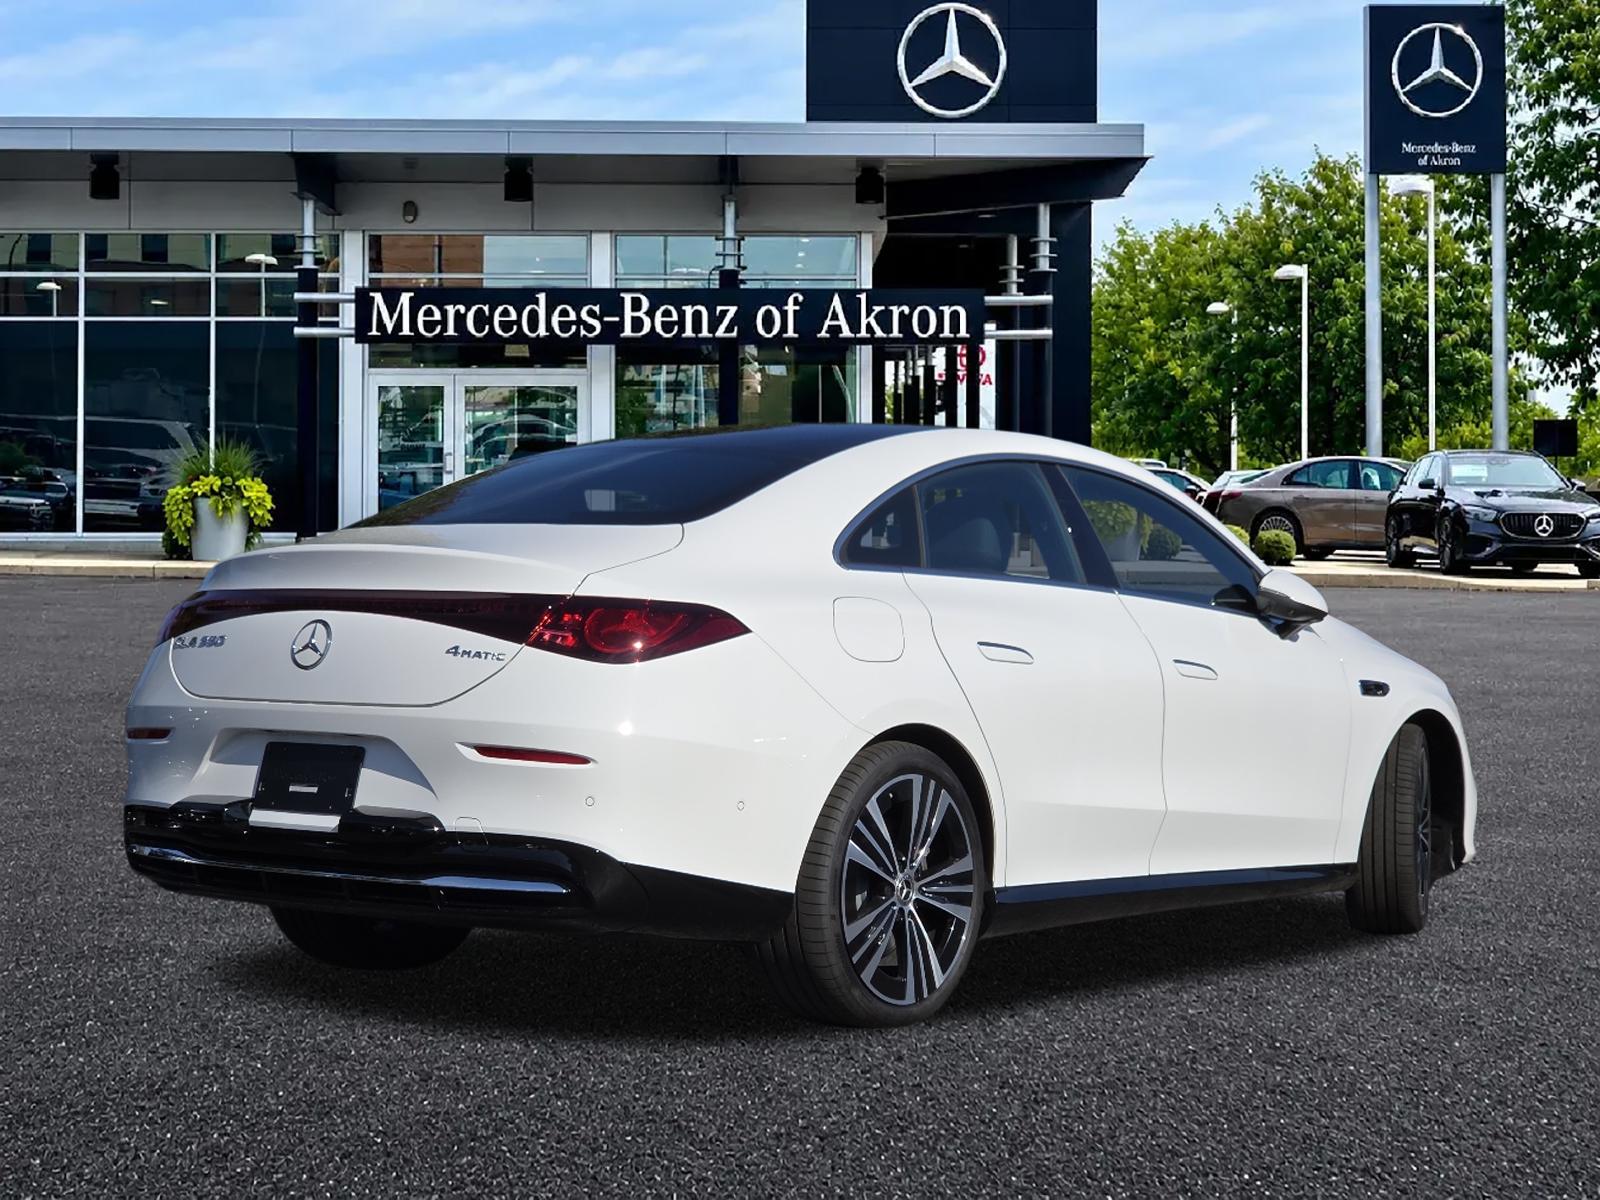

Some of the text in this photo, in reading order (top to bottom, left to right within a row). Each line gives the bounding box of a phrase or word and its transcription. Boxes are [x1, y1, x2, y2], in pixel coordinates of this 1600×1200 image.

[1401, 141, 1477, 154] Mercedes-Benz
[1417, 155, 1461, 166] of Akron
[367, 291, 970, 338] Mercedes-Benz of Akron
[445, 645, 506, 662] 4MATIC
